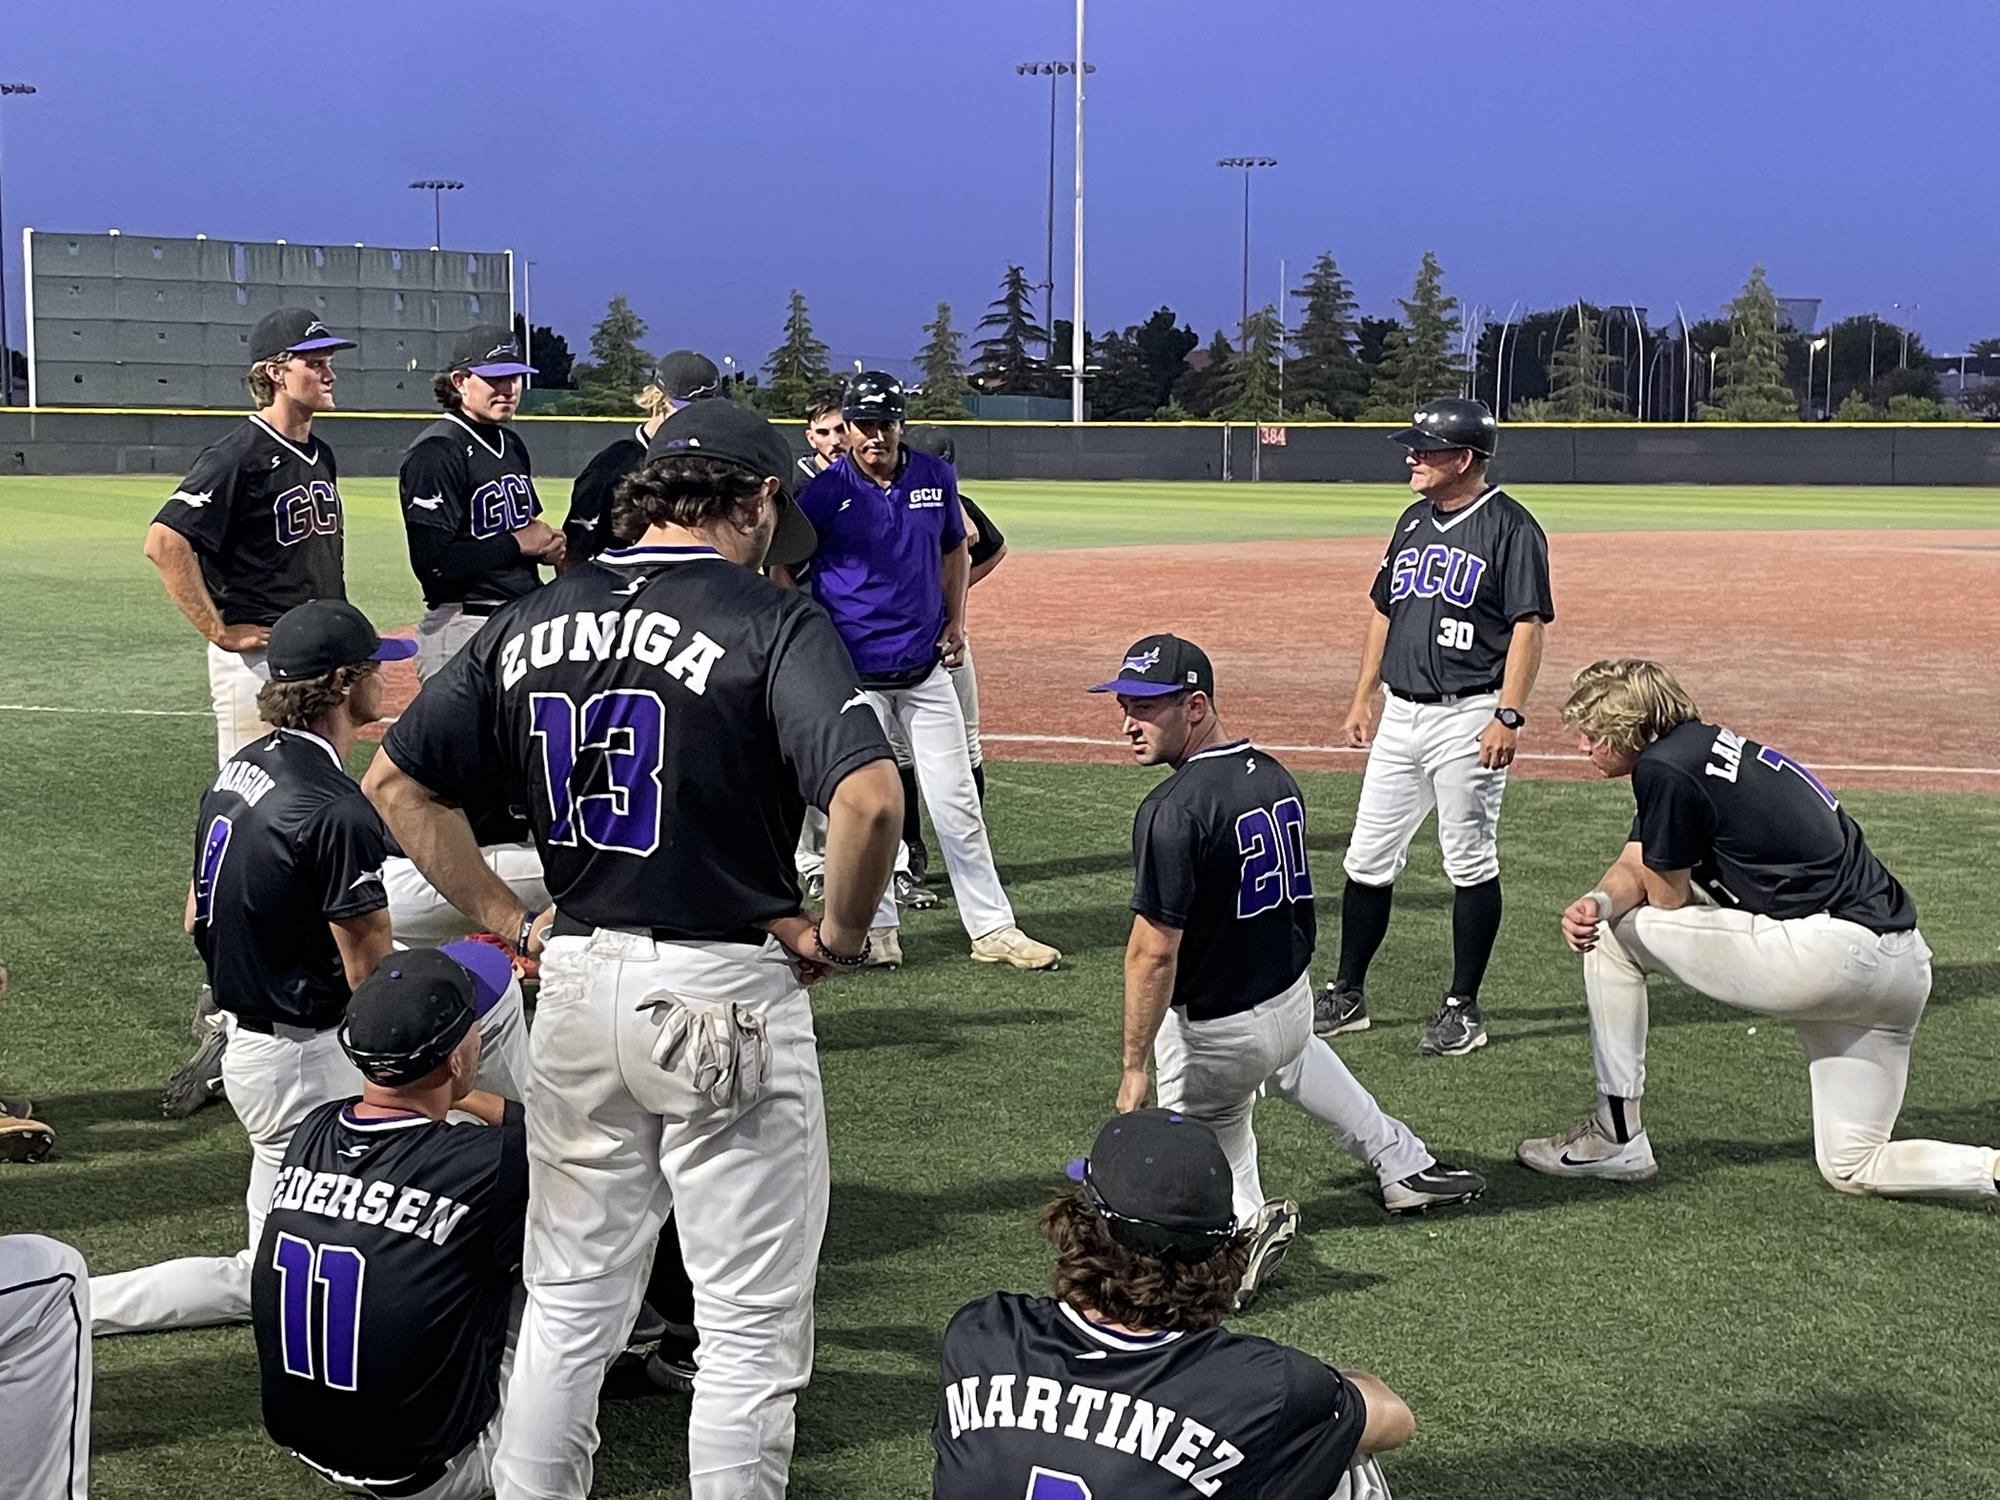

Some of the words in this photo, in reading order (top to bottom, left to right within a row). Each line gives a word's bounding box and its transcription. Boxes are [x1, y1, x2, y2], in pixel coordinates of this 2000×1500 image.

[1260, 427, 1287, 446] 384
[909, 488, 942, 503] GCU
[1390, 544, 1487, 609] GCU
[501, 608, 726, 696] ZUNIGA
[1437, 617, 1474, 651] 30
[529, 688, 665, 857] 13
[1235, 796, 1314, 919] 20
[273, 1230, 366, 1392] 11
[945, 1374, 1245, 1498] MARTINEZ
